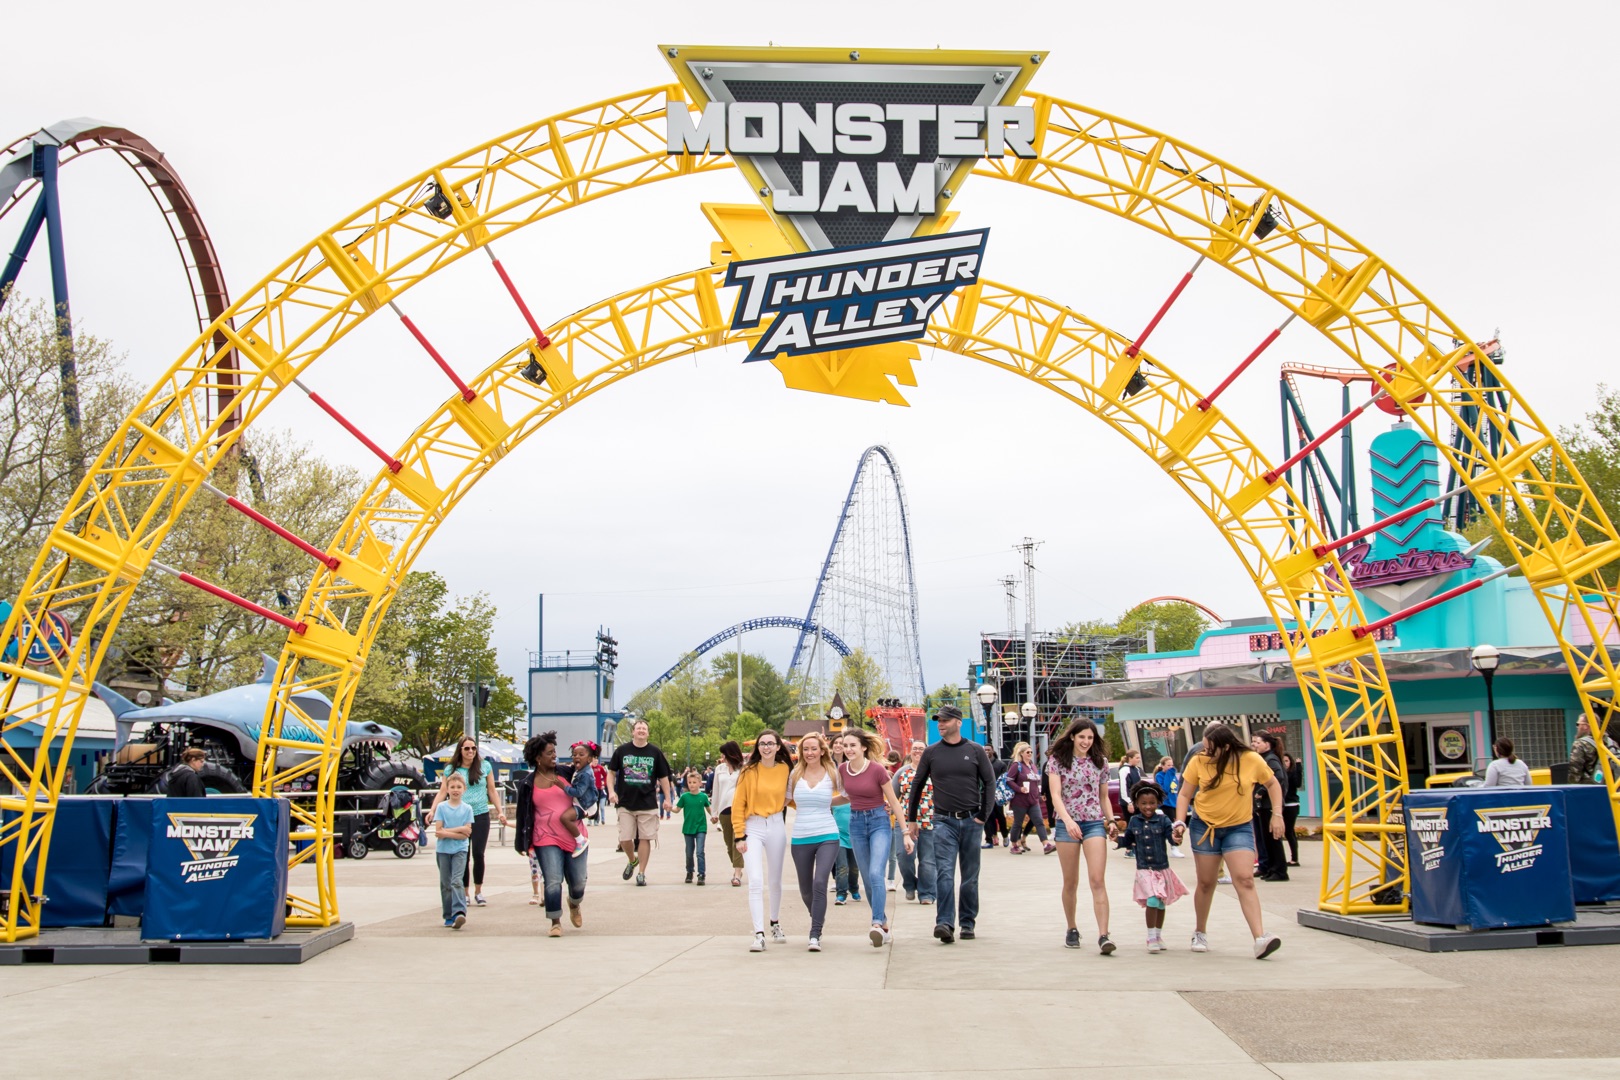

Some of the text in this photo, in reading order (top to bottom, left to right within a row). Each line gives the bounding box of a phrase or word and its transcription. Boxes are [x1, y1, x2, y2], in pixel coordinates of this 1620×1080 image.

[666, 101, 1037, 158] MONSTER
[773, 161, 936, 215] JAM
[735, 232, 983, 321] THUNDER
[760, 294, 942, 353] ALLEY
[1325, 543, 1476, 590] Coasters
[393, 777, 413, 785] BKT
[1410, 818, 1449, 831] MONSTER
[1477, 816, 1552, 832] MONSTER
[166, 825, 254, 839] MONSTER
[1421, 831, 1438, 843] JAM
[1500, 830, 1533, 843] JAM
[190, 838, 230, 851] JAM
[1420, 846, 1445, 865] THUNDER
[1494, 844, 1543, 867] THUNDER
[180, 855, 240, 876] THUNDER
[1424, 859, 1440, 872] ALLEY
[1501, 858, 1536, 873] ALLEY
[185, 868, 229, 883] ALLEY
